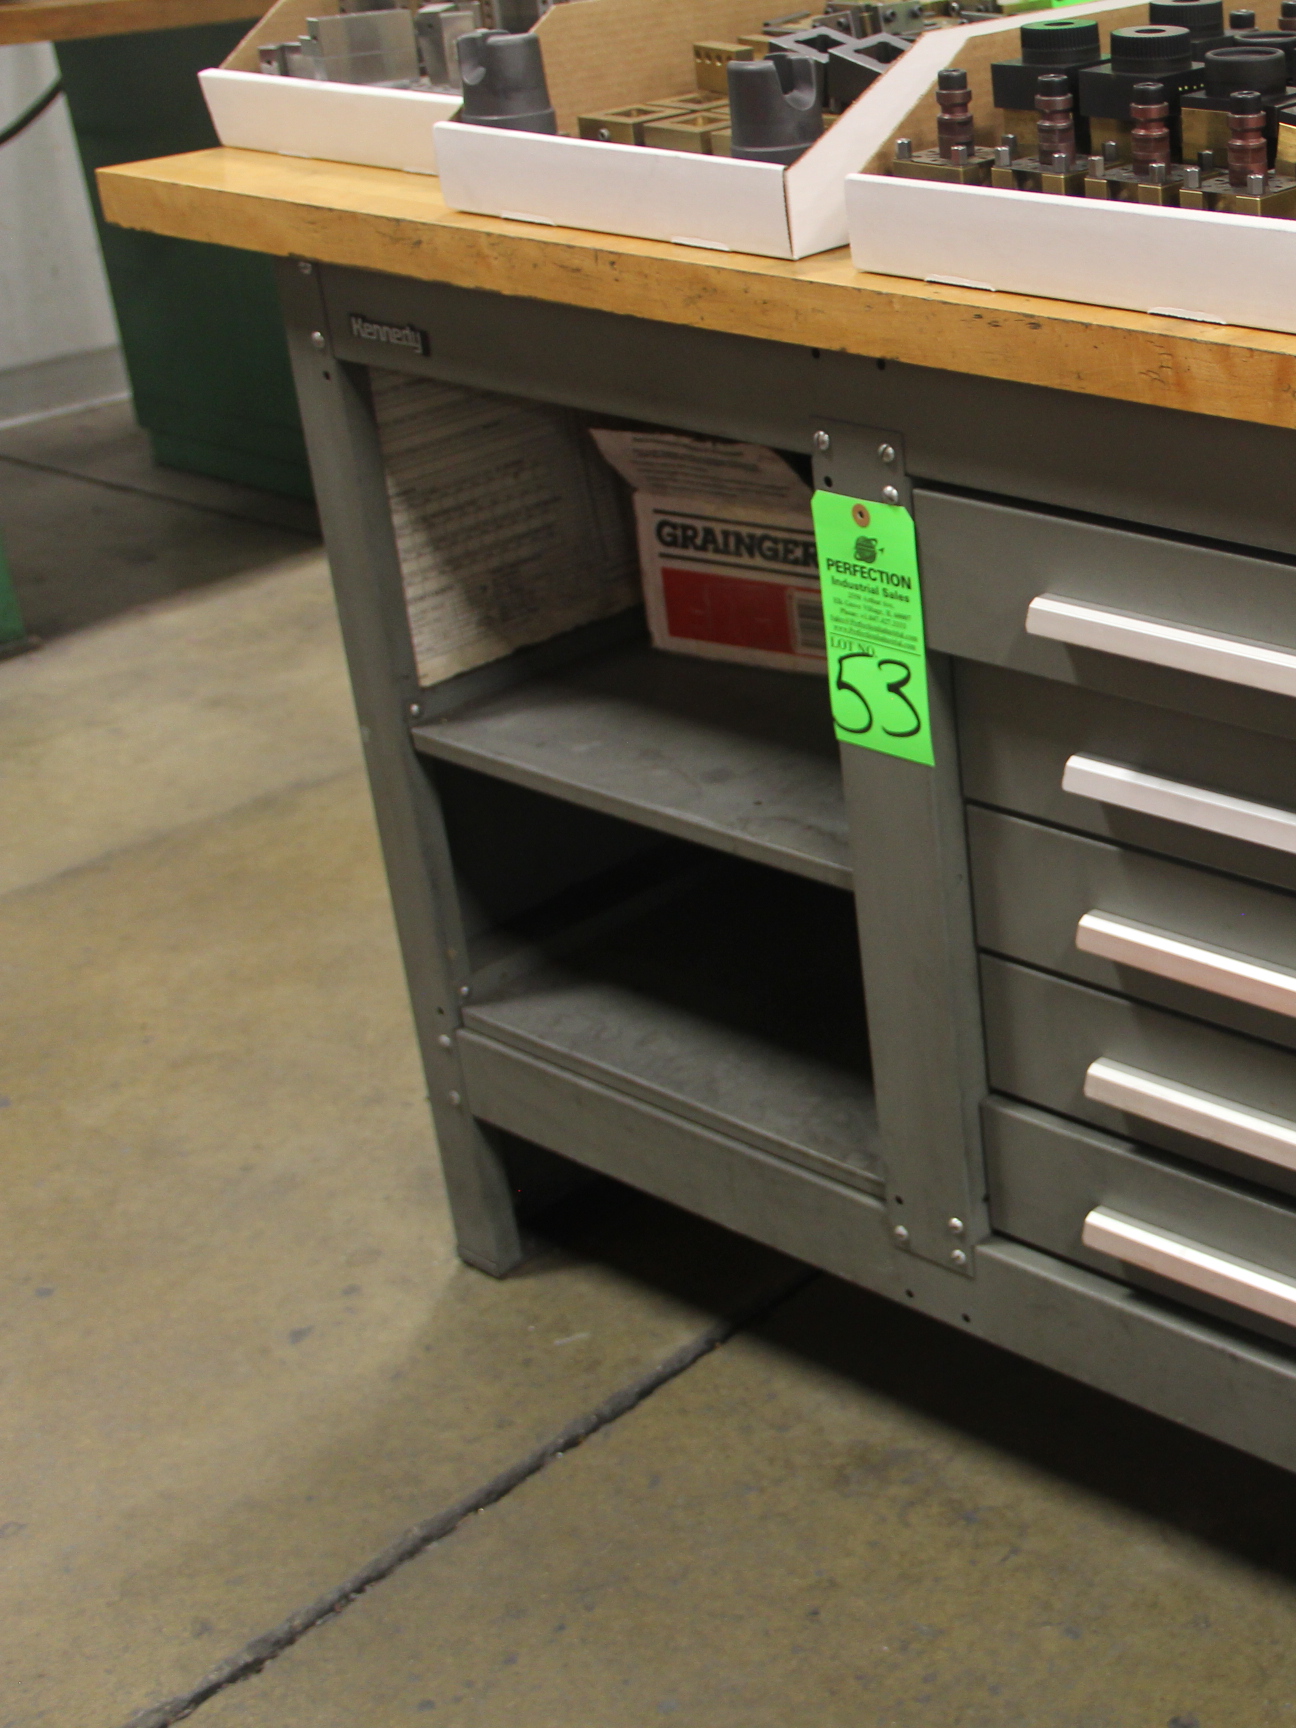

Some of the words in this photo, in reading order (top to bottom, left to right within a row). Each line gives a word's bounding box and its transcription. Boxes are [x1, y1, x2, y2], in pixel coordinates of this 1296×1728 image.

[655, 519, 819, 570] GRAINGER
[826, 557, 912, 590] PERFECTION
[831, 575, 879, 596] Industrial
[882, 587, 910, 603] Sales
[830, 636, 853, 652] LOT
[832, 652, 922, 738] 53
